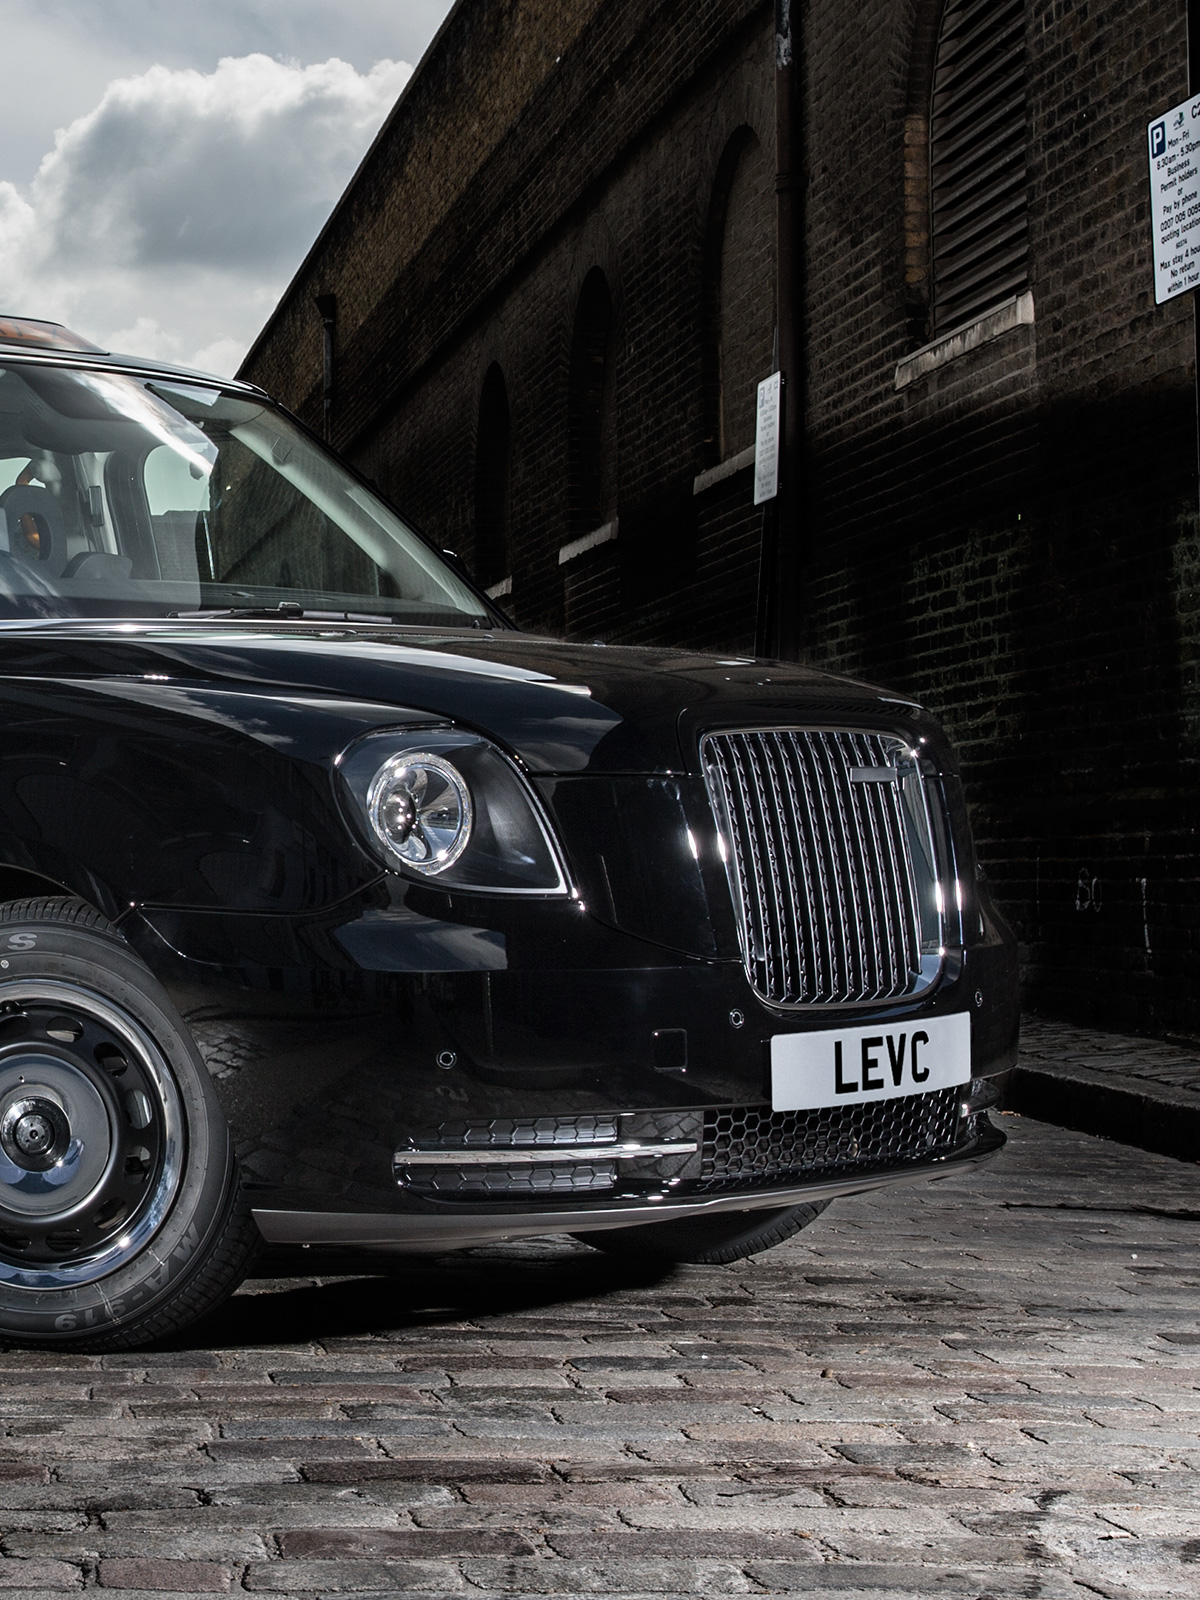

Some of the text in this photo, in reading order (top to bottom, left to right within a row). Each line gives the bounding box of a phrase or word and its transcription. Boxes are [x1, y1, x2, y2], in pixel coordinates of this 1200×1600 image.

[1153, 127, 1162, 154] P
[1182, 129, 1190, 141] Fri
[1167, 158, 1190, 177] Business
[1161, 167, 1198, 193] Permit holders
[1177, 187, 1183, 196] or
[1163, 191, 1197, 215] Pay by phone
[1160, 217, 1174, 232] 0207
[1175, 210, 1186, 224] 005
[1161, 229, 1180, 245] quoting
[1160, 260, 1171, 271] Max
[1172, 253, 1183, 265] stay
[1170, 261, 1195, 279] No return
[1168, 280, 1183, 293] within
[1188, 272, 1200, 284] hour
[834, 1030, 930, 1094] LEVC
